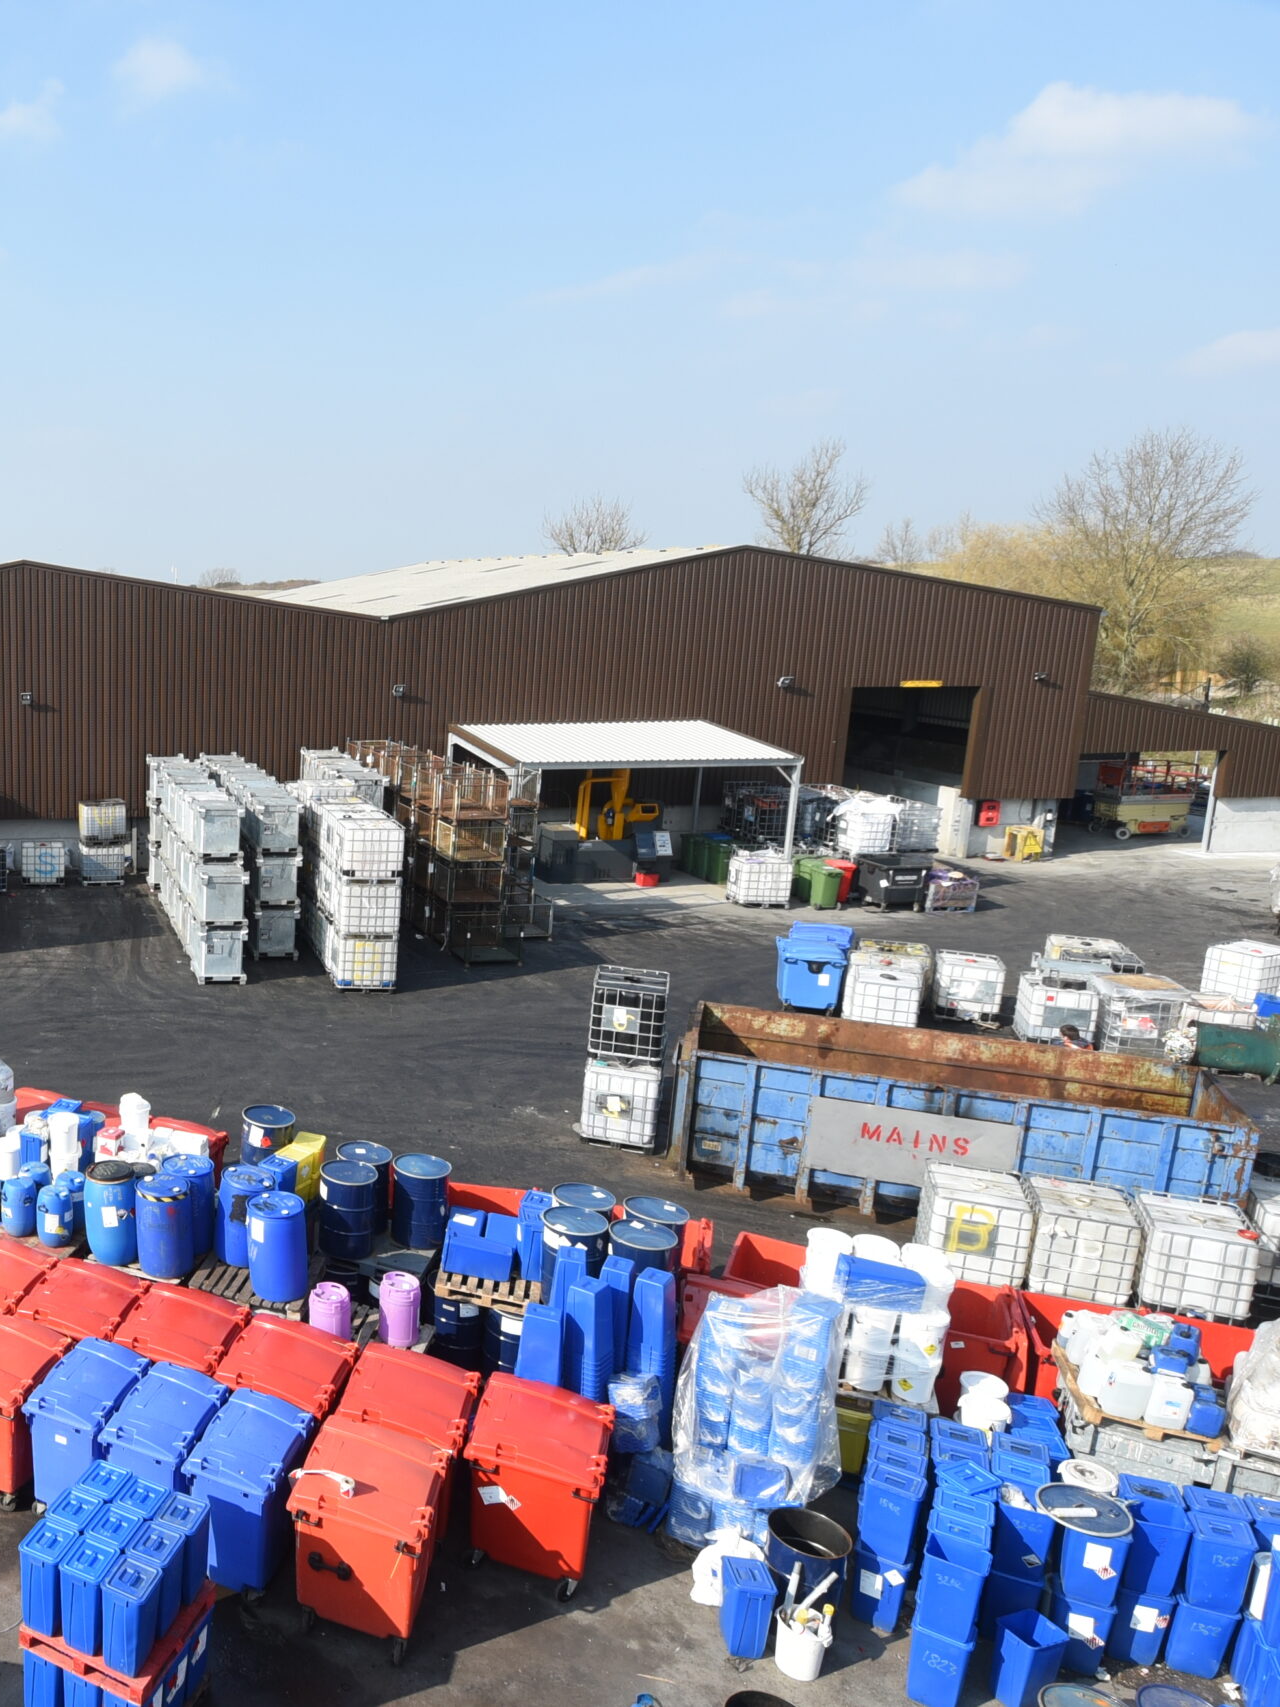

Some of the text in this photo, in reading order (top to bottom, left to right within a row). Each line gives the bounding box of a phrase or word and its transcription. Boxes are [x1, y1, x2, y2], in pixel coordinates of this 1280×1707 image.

[35, 851, 59, 875] S
[860, 1122, 972, 1156] MAINS
[944, 1204, 996, 1255] B
[921, 1649, 958, 1677] 1823
